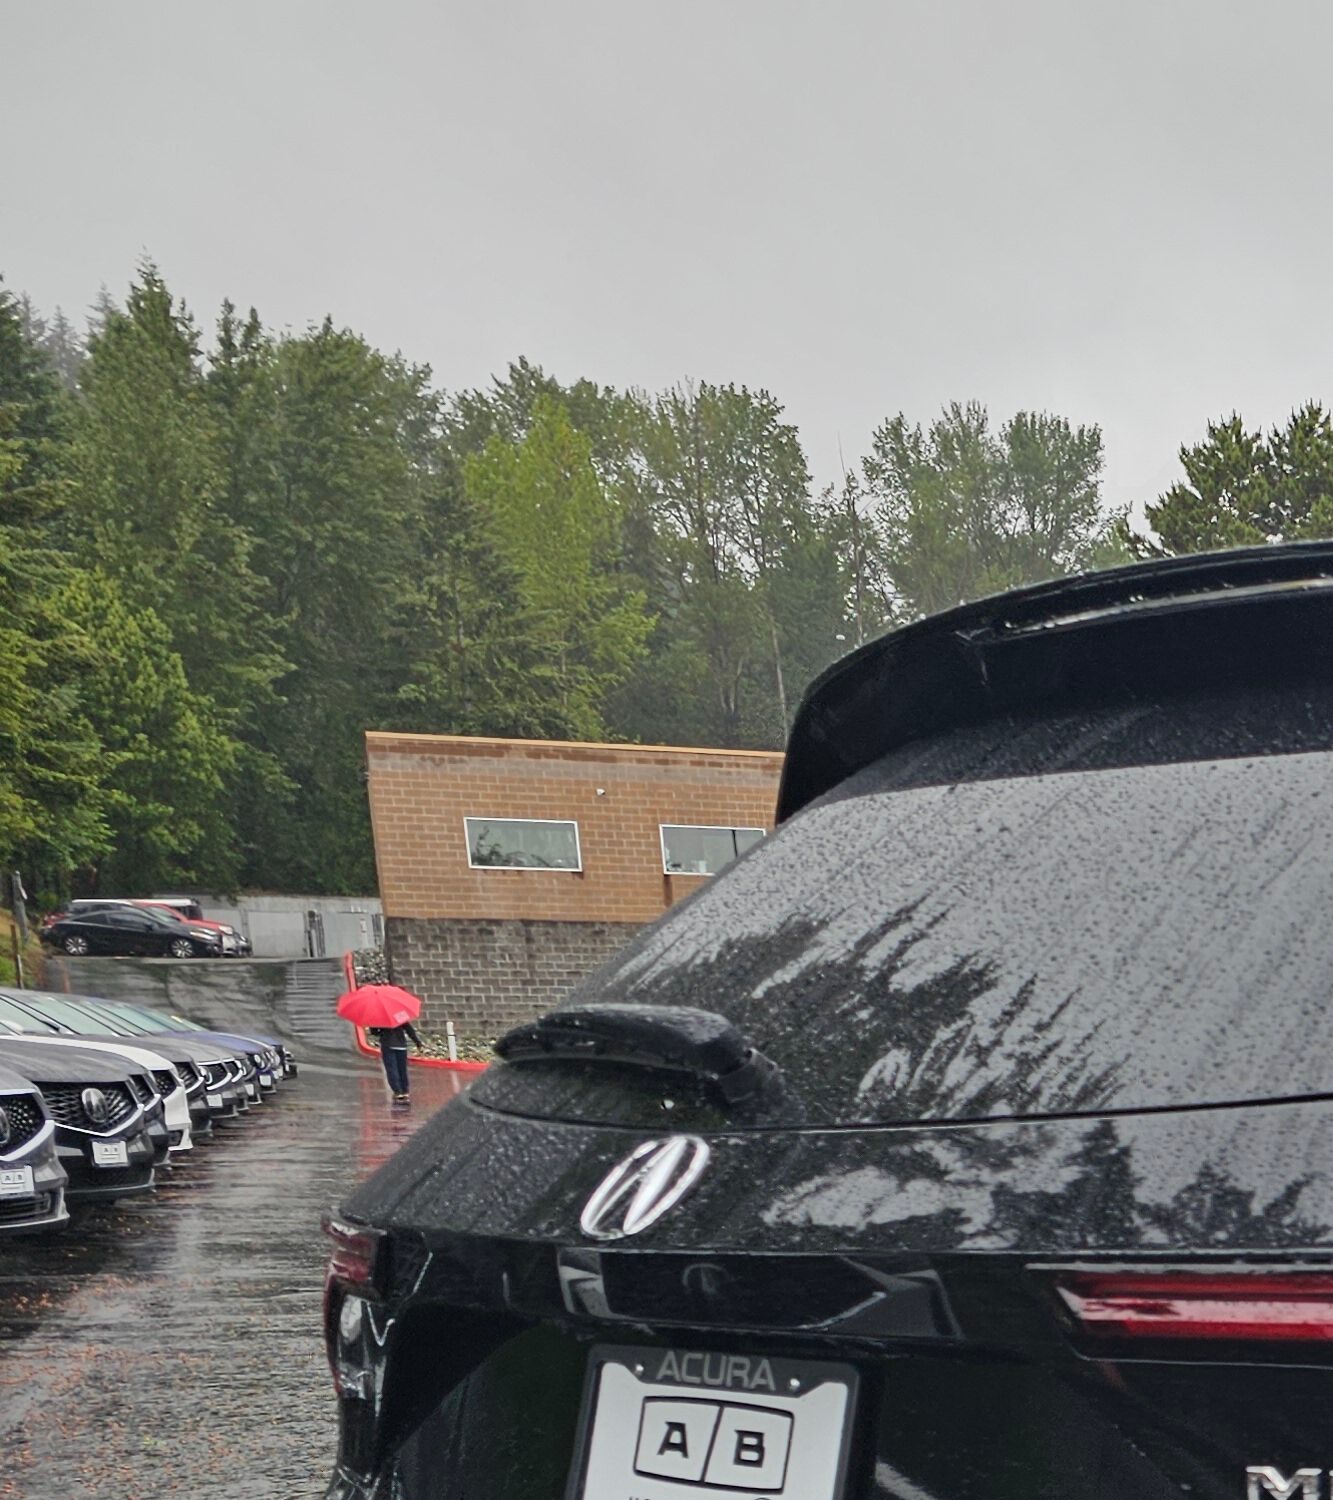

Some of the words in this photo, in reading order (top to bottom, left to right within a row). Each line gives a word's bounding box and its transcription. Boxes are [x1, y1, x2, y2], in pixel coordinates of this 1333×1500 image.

[656, 1350, 776, 1391] ACURA
[656, 1421, 689, 1459] A
[734, 1429, 766, 1468] B
